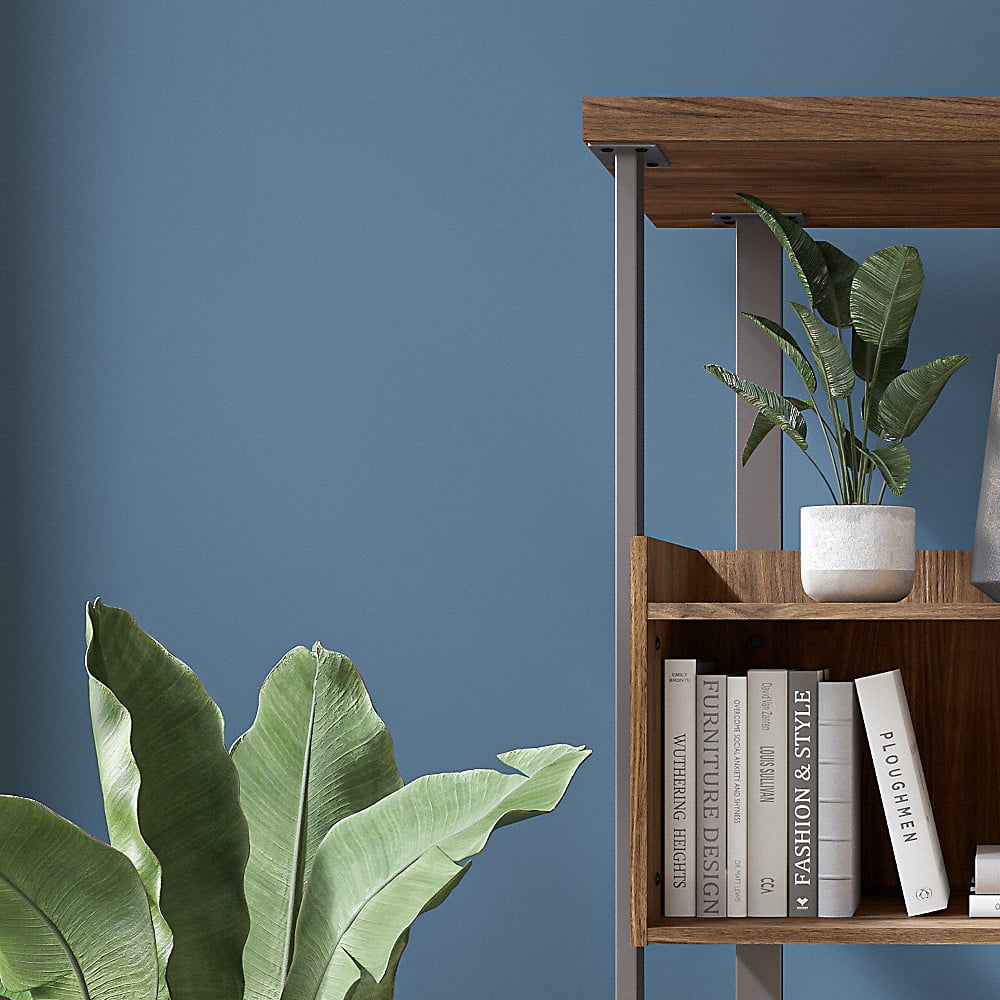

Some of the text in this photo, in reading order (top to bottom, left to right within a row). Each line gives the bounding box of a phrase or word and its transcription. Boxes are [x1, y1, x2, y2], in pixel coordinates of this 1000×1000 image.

[673, 733, 687, 889] WUTHERING HEIGHTS
[702, 679, 720, 915] FURNITURE DESIGN
[733, 699, 741, 824] OVERCOME SOCIAL ANXIETY AND SHYNESS
[760, 745, 775, 803] LOUIS SULLIVAN
[794, 690, 811, 886] FASHION & STYLE
[879, 731, 918, 843] PLOUGHMEN
[760, 877, 775, 894] CCA
